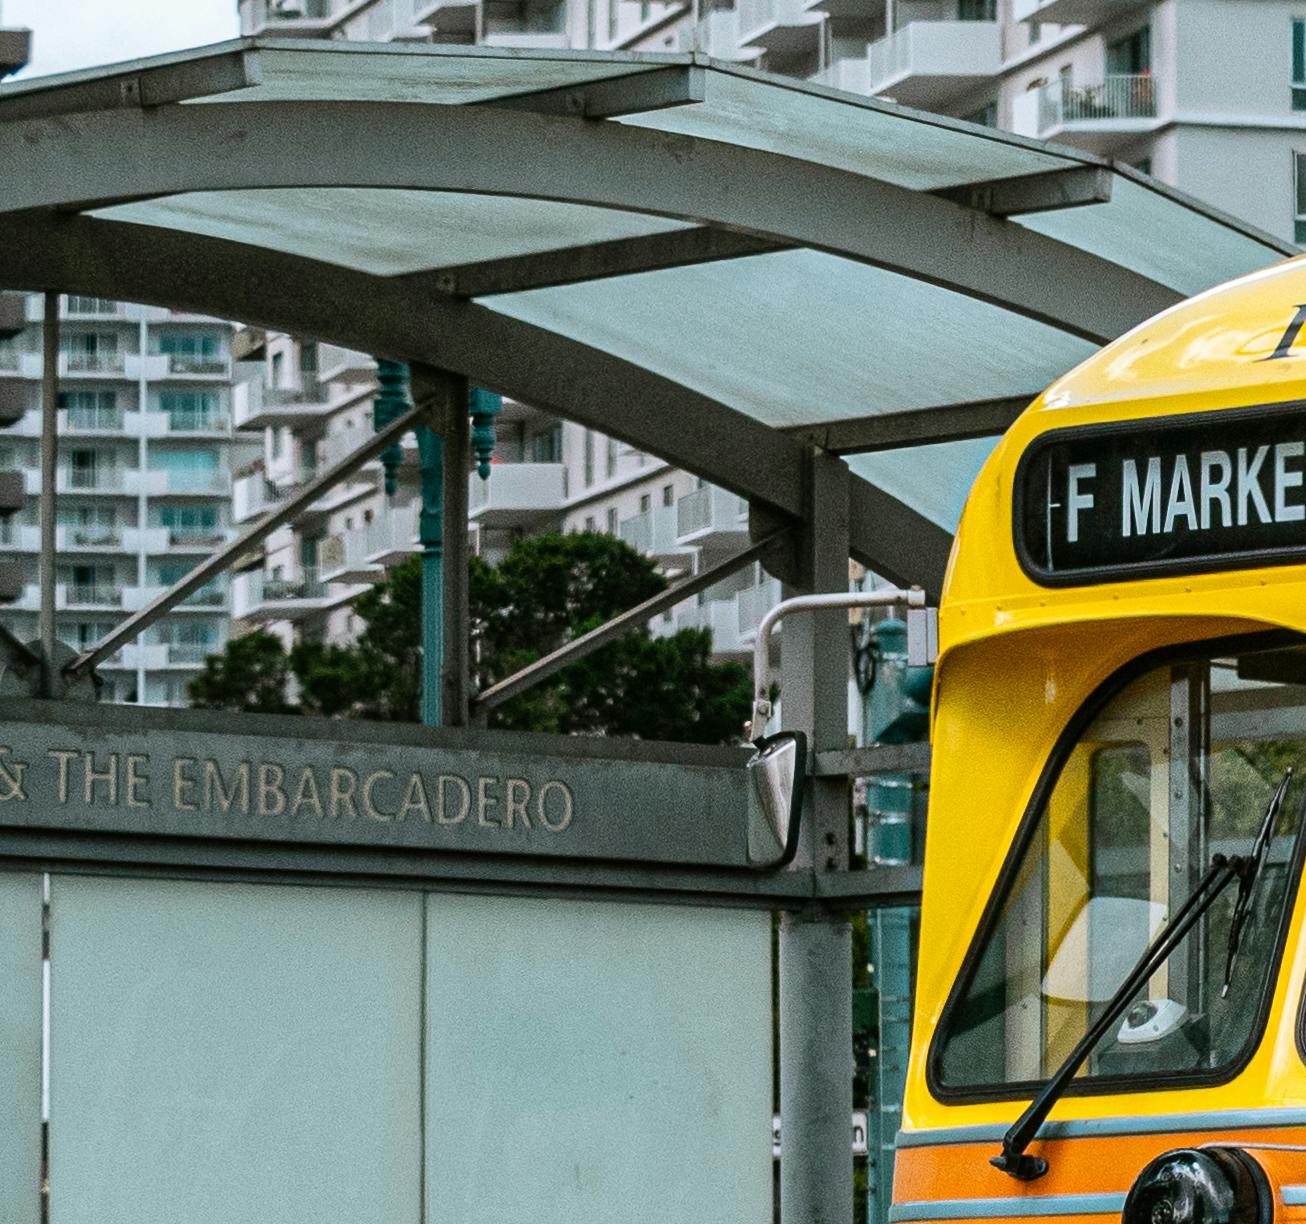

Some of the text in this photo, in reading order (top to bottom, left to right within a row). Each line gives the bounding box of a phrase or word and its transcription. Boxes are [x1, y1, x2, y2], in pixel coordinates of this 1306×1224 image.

[1066, 462, 1097, 544] F
[47, 748, 152, 808] THE
[172, 757, 575, 833] EMBARCADERO
